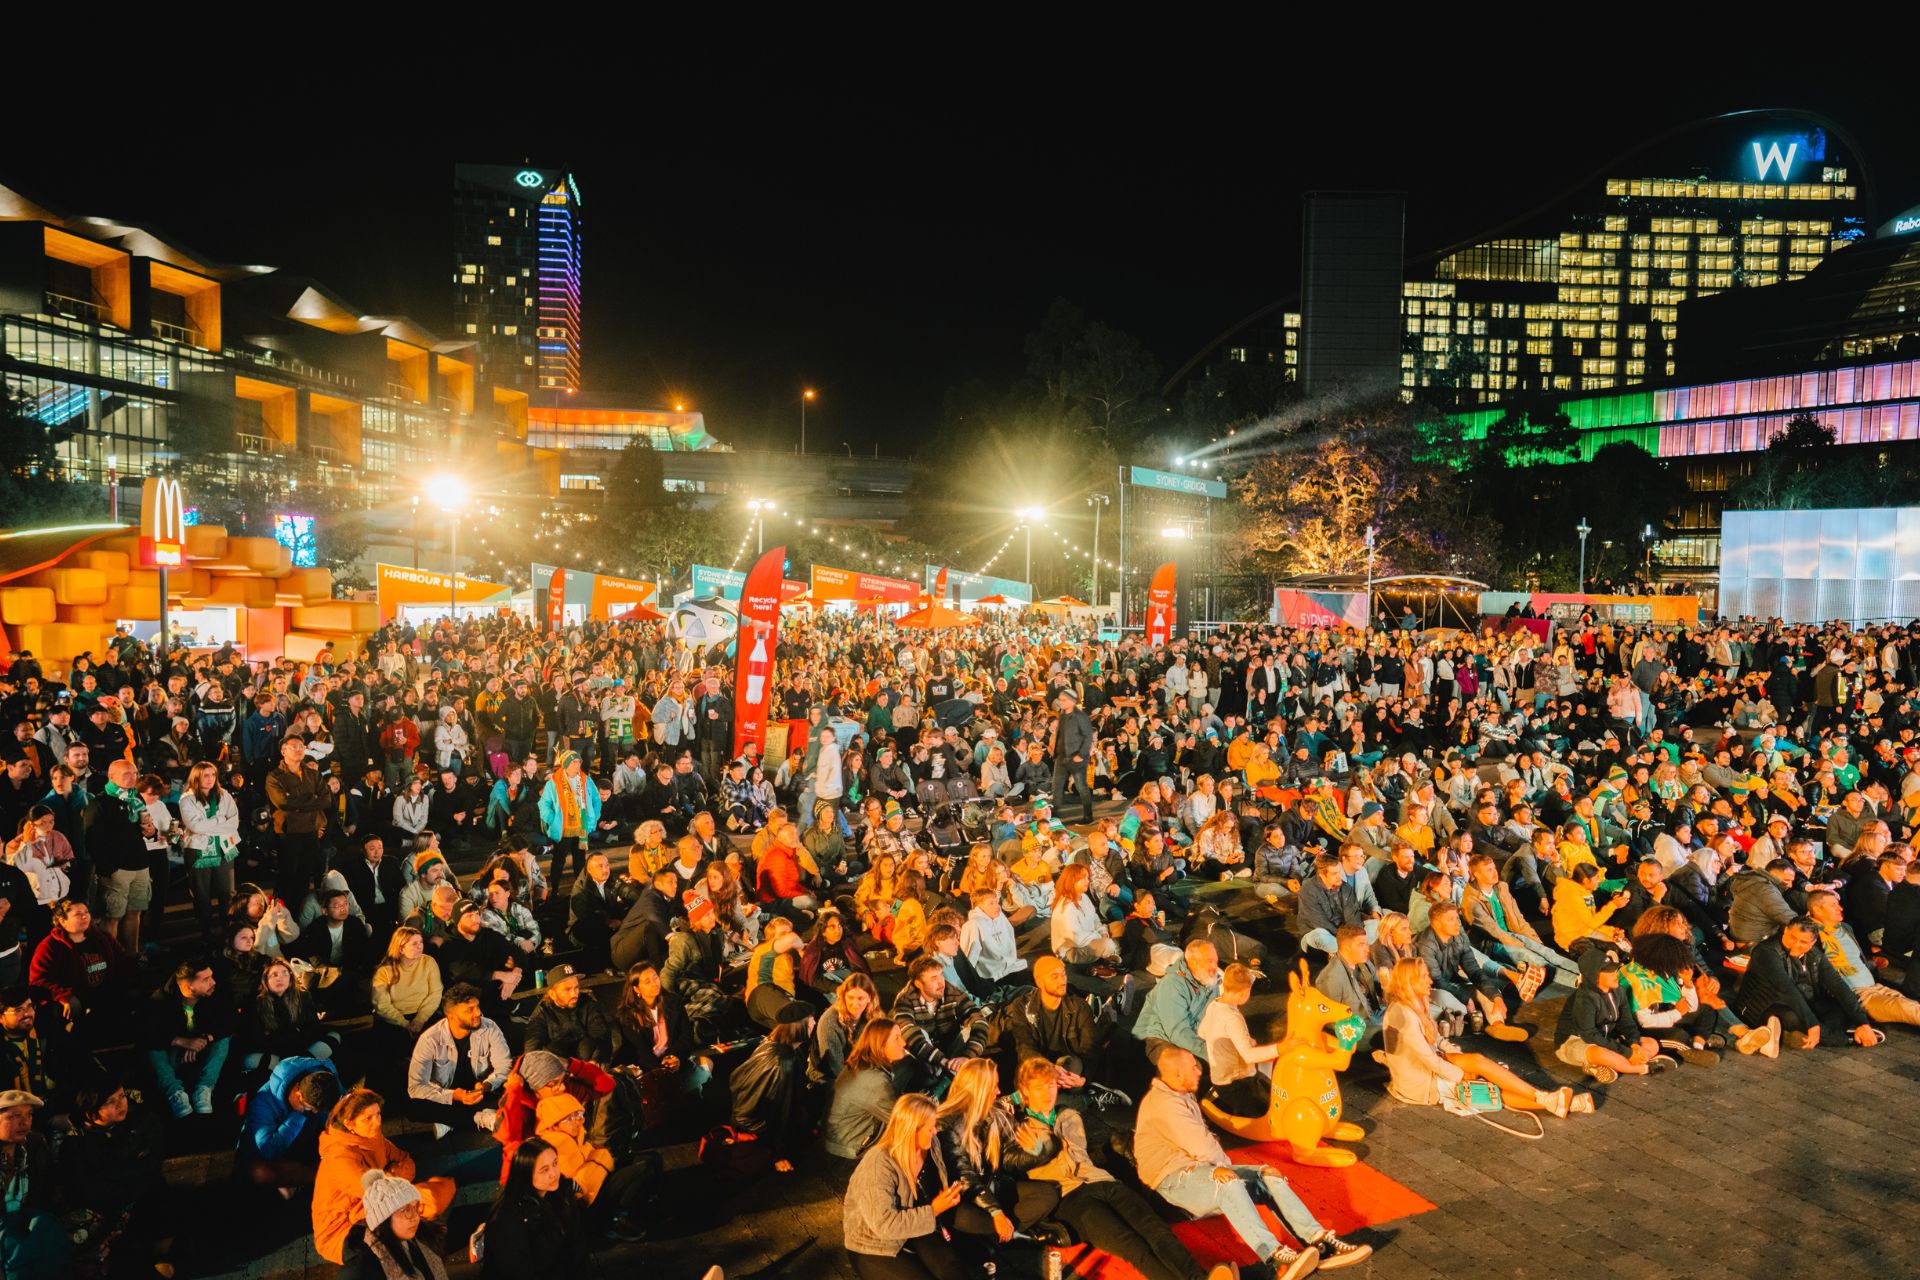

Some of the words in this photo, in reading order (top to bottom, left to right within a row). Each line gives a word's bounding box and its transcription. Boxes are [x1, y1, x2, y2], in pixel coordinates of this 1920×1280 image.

[1753, 142, 1798, 181] W
[1156, 474, 1180, 487] SYDNEY
[383, 568, 441, 586] HARBOUR
[816, 569, 842, 579] COFFEE
[602, 579, 644, 592] DUMPLINGS
[816, 575, 844, 585] SWEETS
[860, 577, 912, 591] INTERNATIONAL
[785, 584, 801, 592] BBQ
[860, 583, 886, 592] CUISINE
[748, 596, 778, 606] Recycle
[753, 603, 773, 611] here!
[1300, 612, 1336, 627] SYDNEY
